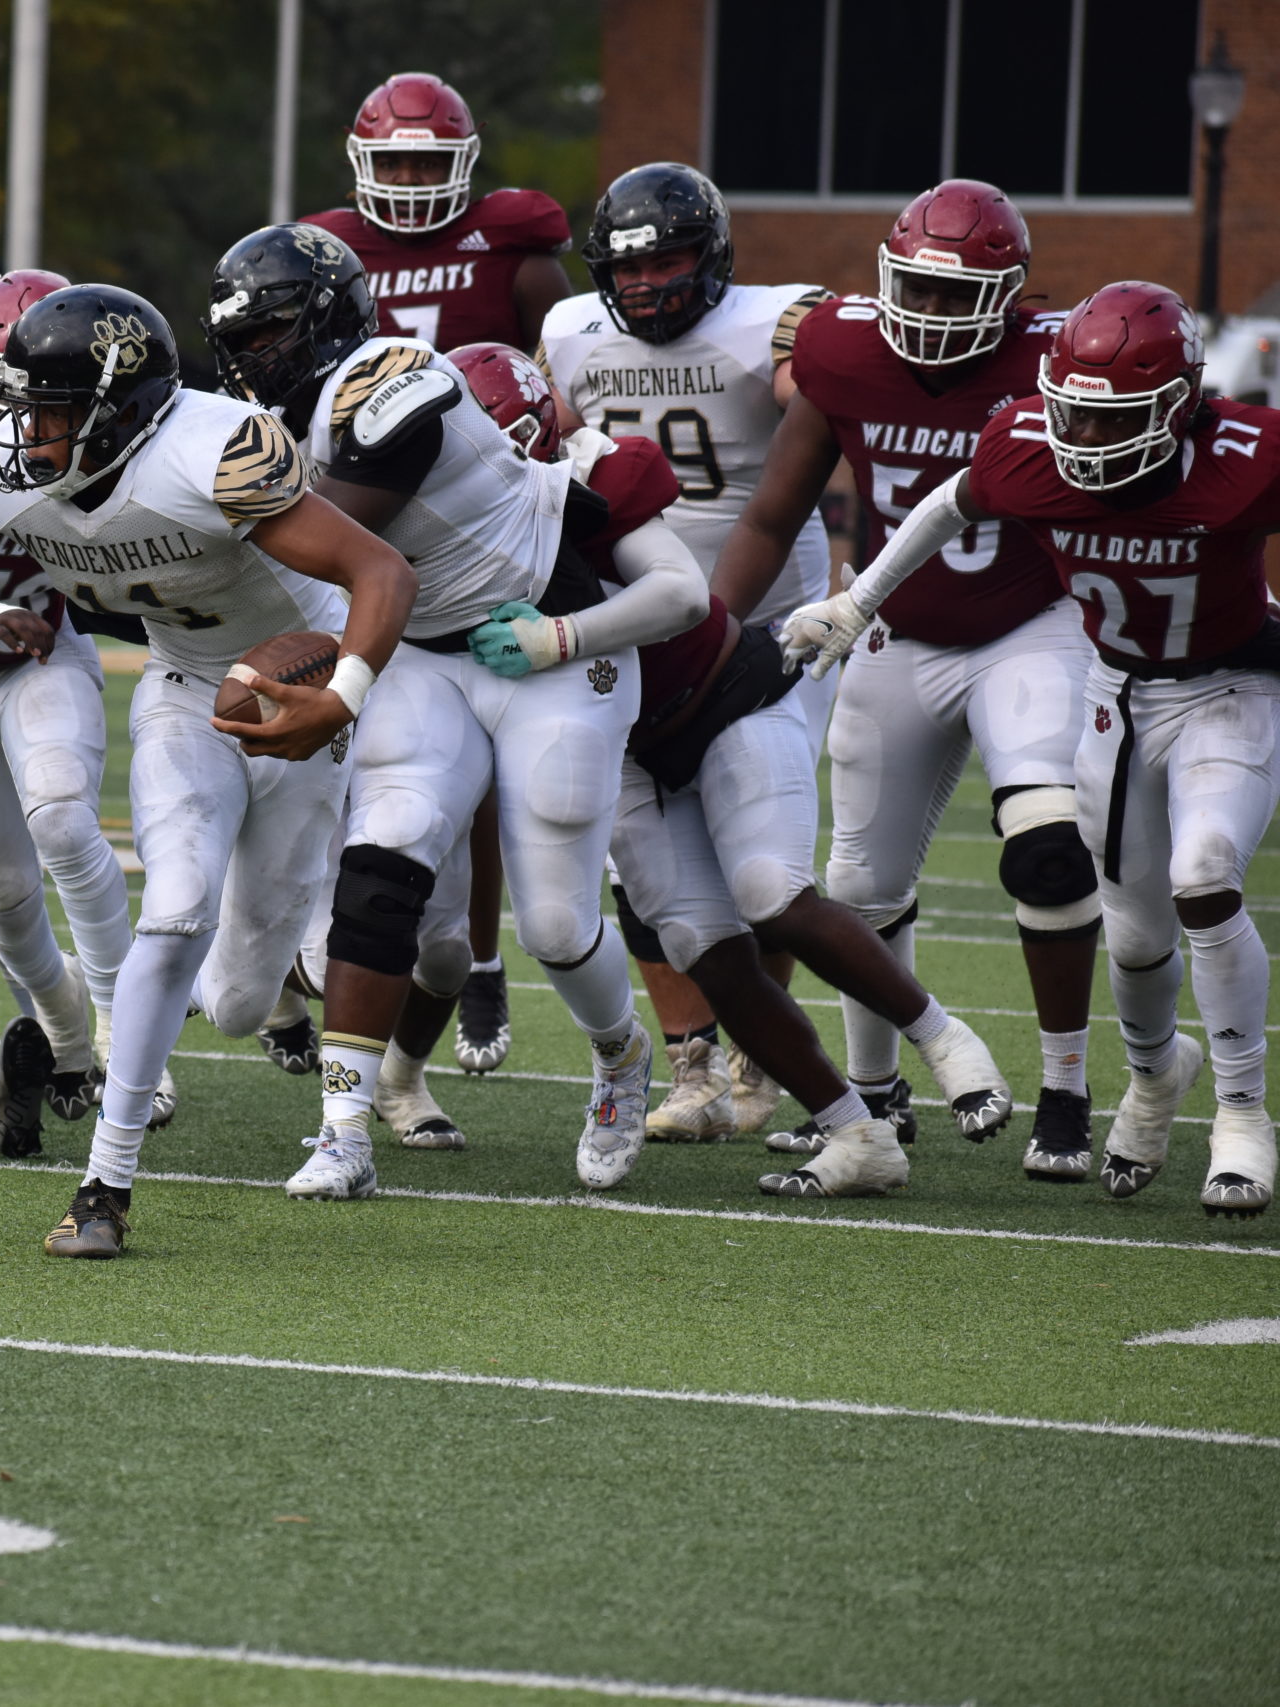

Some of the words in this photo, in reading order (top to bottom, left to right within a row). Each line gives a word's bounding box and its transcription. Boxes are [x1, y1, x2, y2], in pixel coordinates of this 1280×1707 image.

[365, 261, 478, 299] ILDCATS
[367, 372, 425, 417] DOUGLAS
[585, 365, 725, 397] MENDENHALL
[1068, 377, 1106, 391] Riddell
[860, 421, 980, 460] WILDCAT
[10, 528, 204, 575] MENDENHALL
[1050, 527, 1204, 565] WILDCATS
[1070, 571, 1201, 661] 27
[328, 1079, 340, 1089] M
